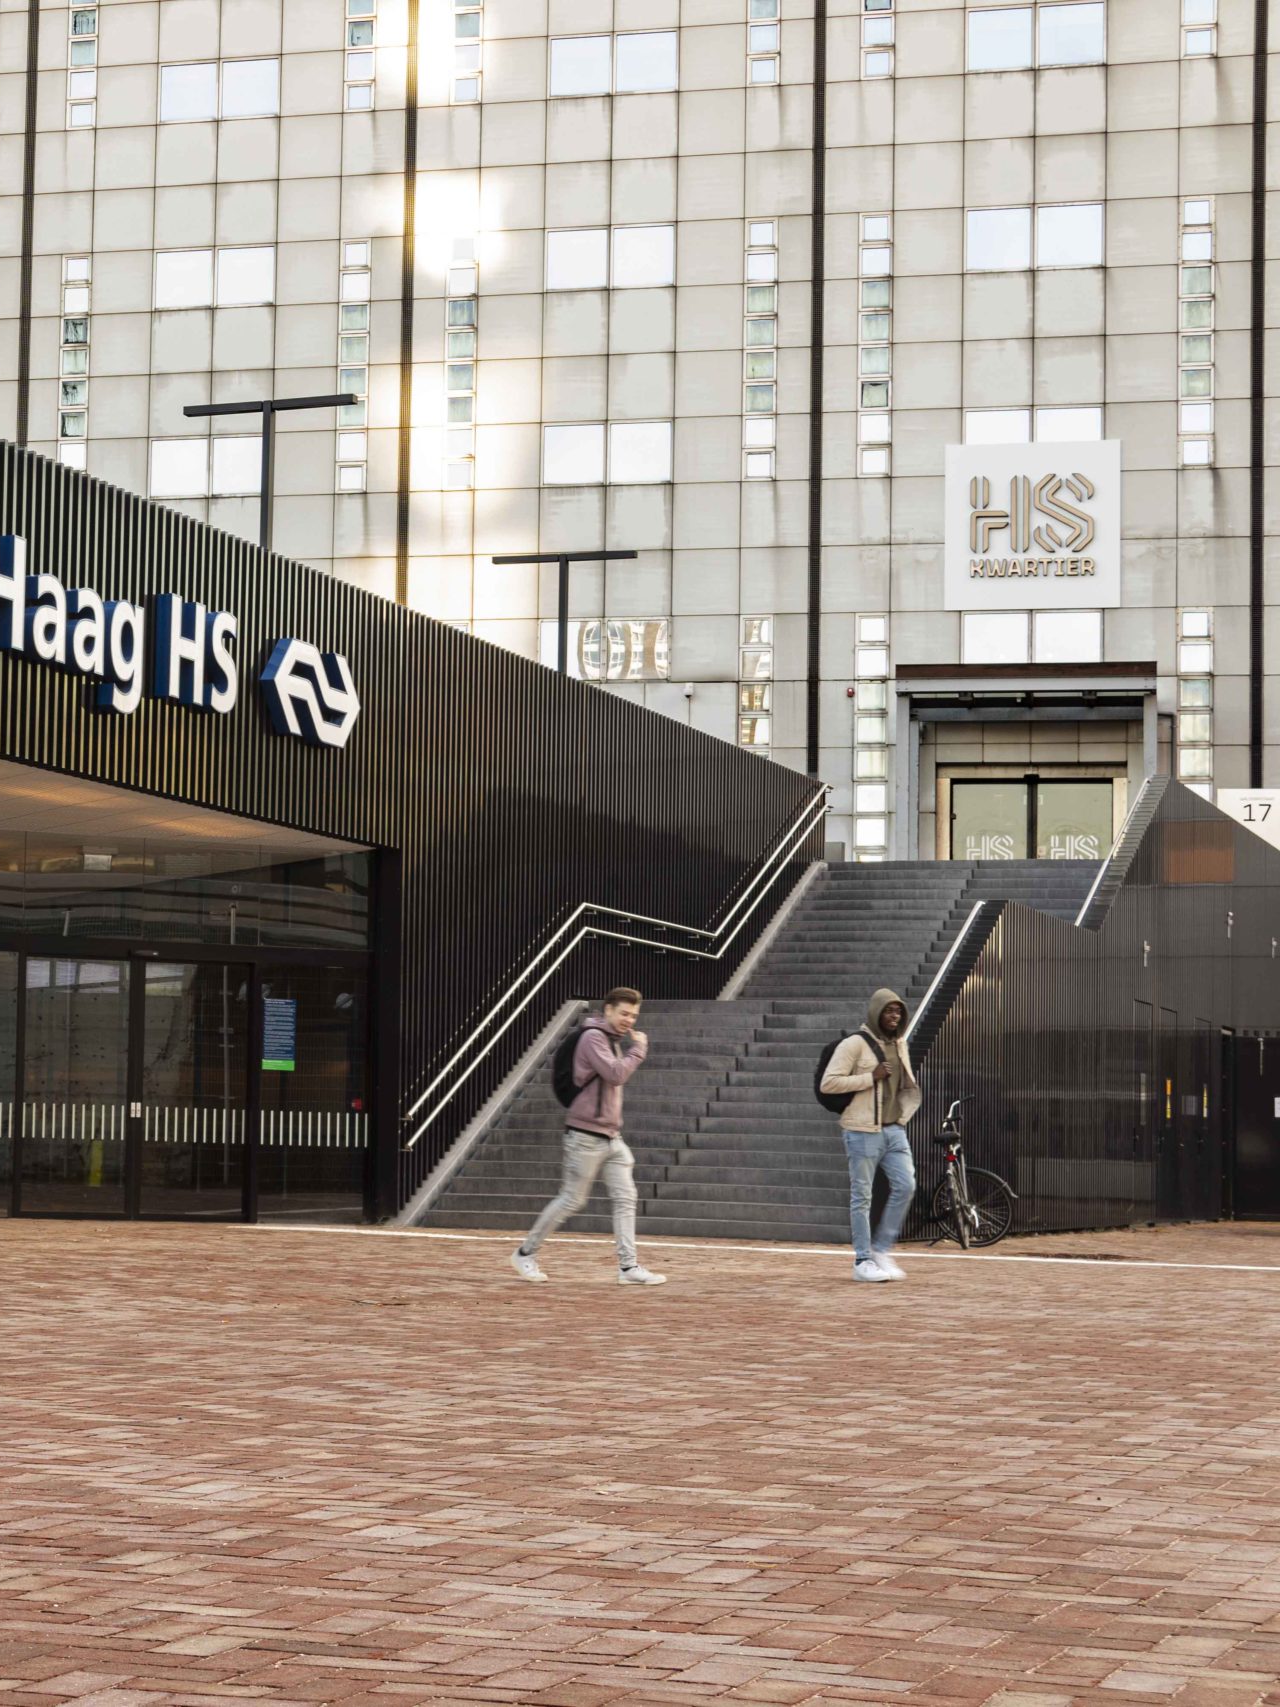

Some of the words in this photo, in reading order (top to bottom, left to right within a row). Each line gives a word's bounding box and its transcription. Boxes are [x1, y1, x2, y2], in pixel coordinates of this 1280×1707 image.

[970, 473, 1095, 553] HS
[970, 558, 1096, 578] KWARTIER
[164, 593, 237, 713] HS
[1243, 803, 1272, 822] 17
[966, 835, 1014, 860] HS
[1050, 835, 1098, 860] HS
